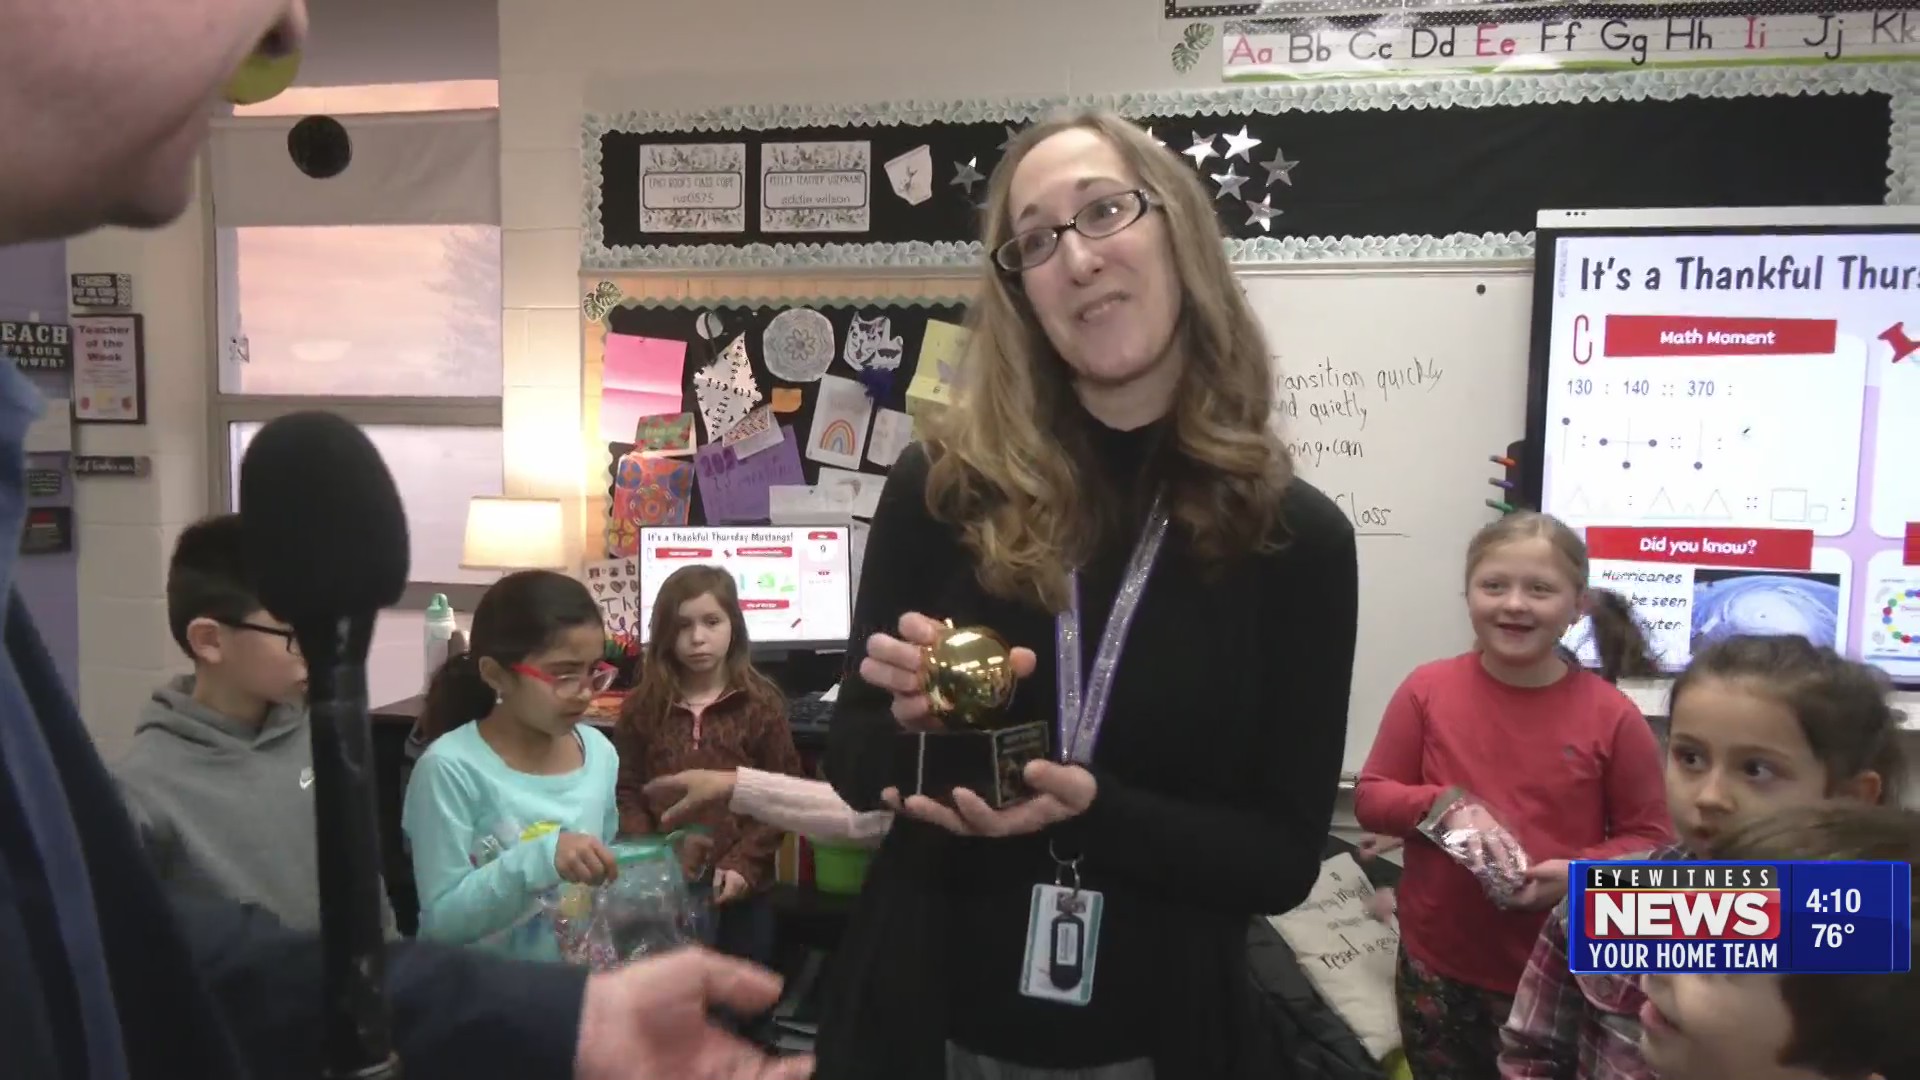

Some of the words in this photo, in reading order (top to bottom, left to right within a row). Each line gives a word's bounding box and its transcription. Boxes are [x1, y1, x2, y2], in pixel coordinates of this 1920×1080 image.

[1228, 33, 1273, 64] Aa
[1288, 33, 1331, 63] Bb
[1349, 30, 1393, 60] Cc
[1411, 27, 1455, 58] Dd
[1476, 23, 1516, 56] Ee
[1540, 21, 1581, 51] Ff
[1600, 19, 1647, 66] Gg
[1666, 17, 1712, 49] Hh
[1745, 15, 1766, 49] Ii
[1803, 13, 1844, 60] Jj
[1872, 11, 1917, 43] Kk
[1581, 257, 1631, 290] It's
[1645, 267, 1661, 290] a
[1676, 255, 1823, 290] Thankful
[1, 323, 68, 344] EACH
[79, 324, 129, 335] Teacher
[1660, 329, 1703, 345] Math
[1706, 331, 1777, 345] Moment
[103, 339, 123, 348] the
[1377, 357, 1443, 401] quickly
[1567, 380, 1593, 396] 130
[1623, 380, 1650, 396] 140
[1687, 380, 1715, 397] 370
[1310, 389, 1367, 431] quietly
[673, 532, 708, 542] Thankful
[712, 532, 748, 543] Thursday
[751, 532, 793, 543] Mustangs!
[1640, 537, 1667, 553] Did
[1669, 540, 1700, 557] you
[1703, 537, 1758, 555] know?
[1602, 569, 1682, 584] Hurricanes
[1652, 596, 1687, 608] seen
